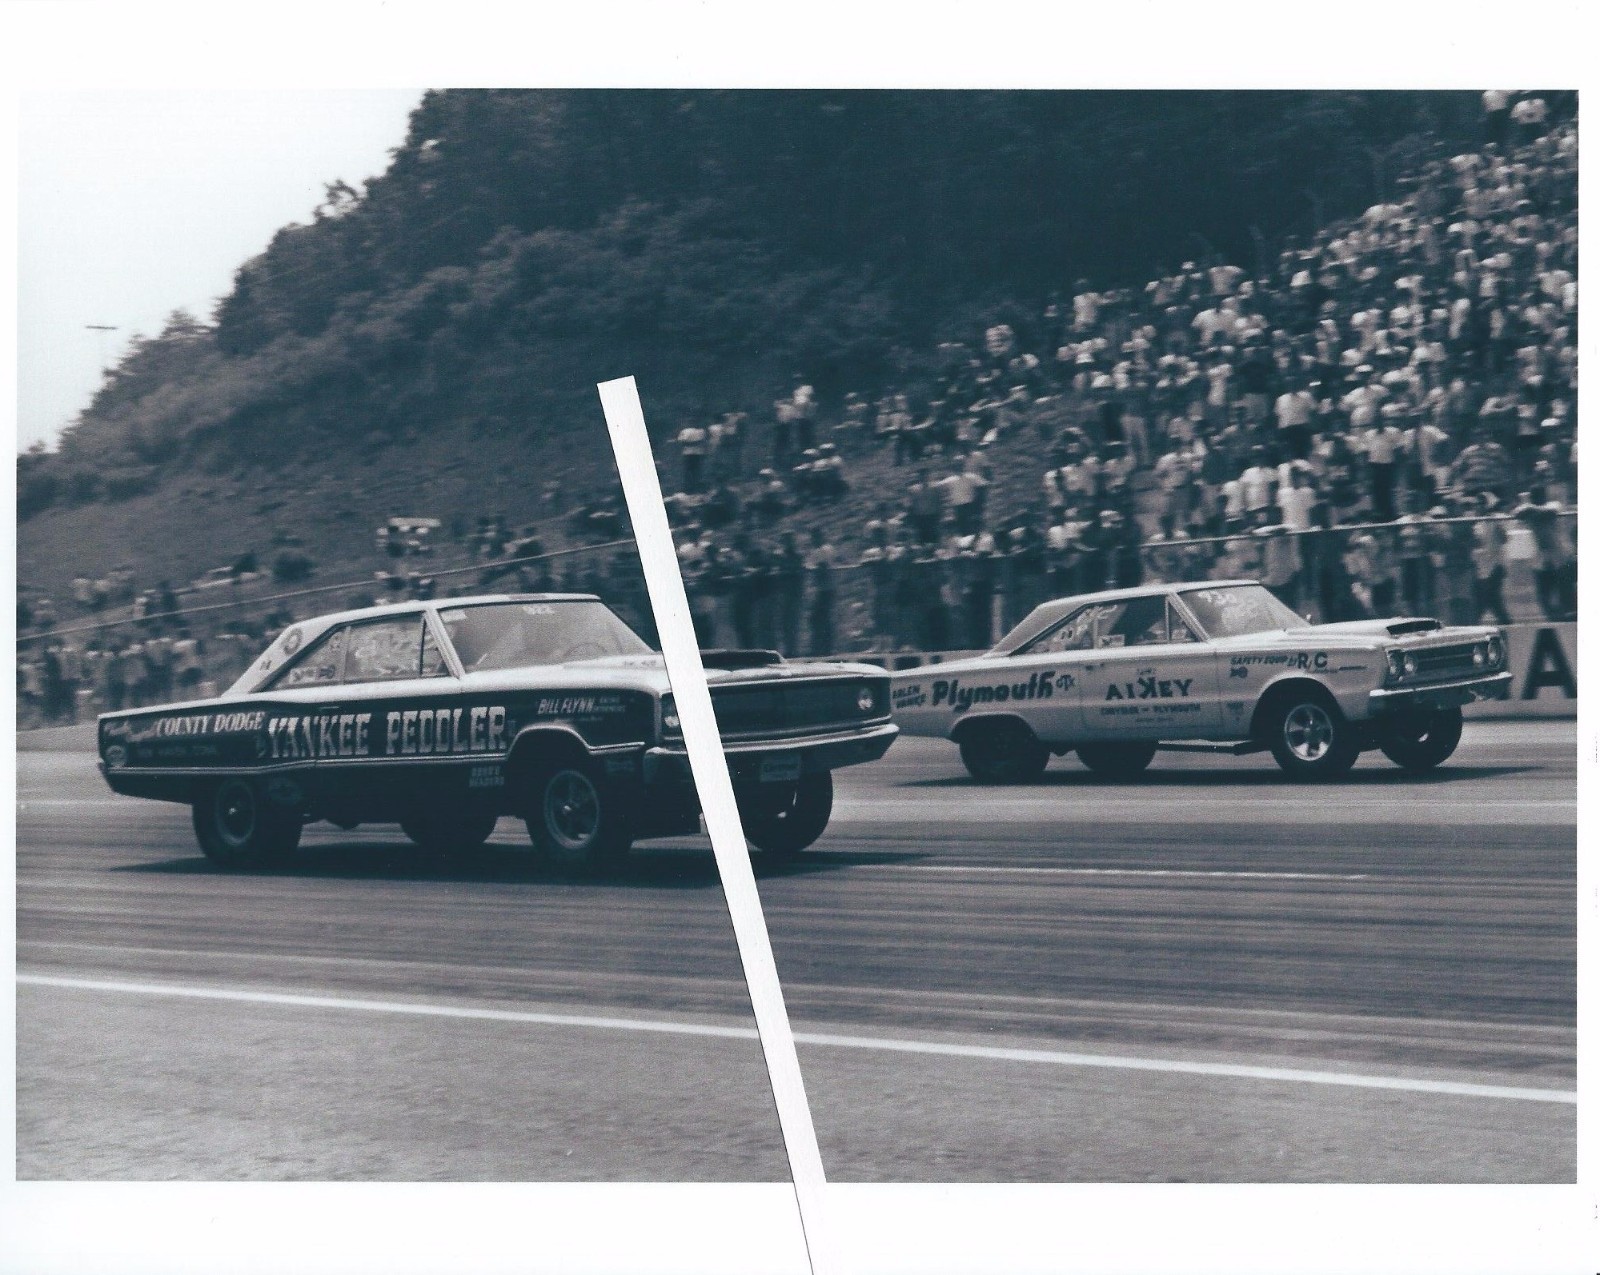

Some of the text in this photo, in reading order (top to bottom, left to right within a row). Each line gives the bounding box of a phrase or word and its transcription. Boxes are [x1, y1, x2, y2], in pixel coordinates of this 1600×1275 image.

[538, 699, 559, 714] BILL
[560, 698, 594, 713] FLYNN
[932, 671, 1056, 712] Plymouth
[156, 715, 212, 736] COUNTY
[214, 711, 265, 732] DODGE
[268, 706, 506, 758] YANKEE PEDDLER
